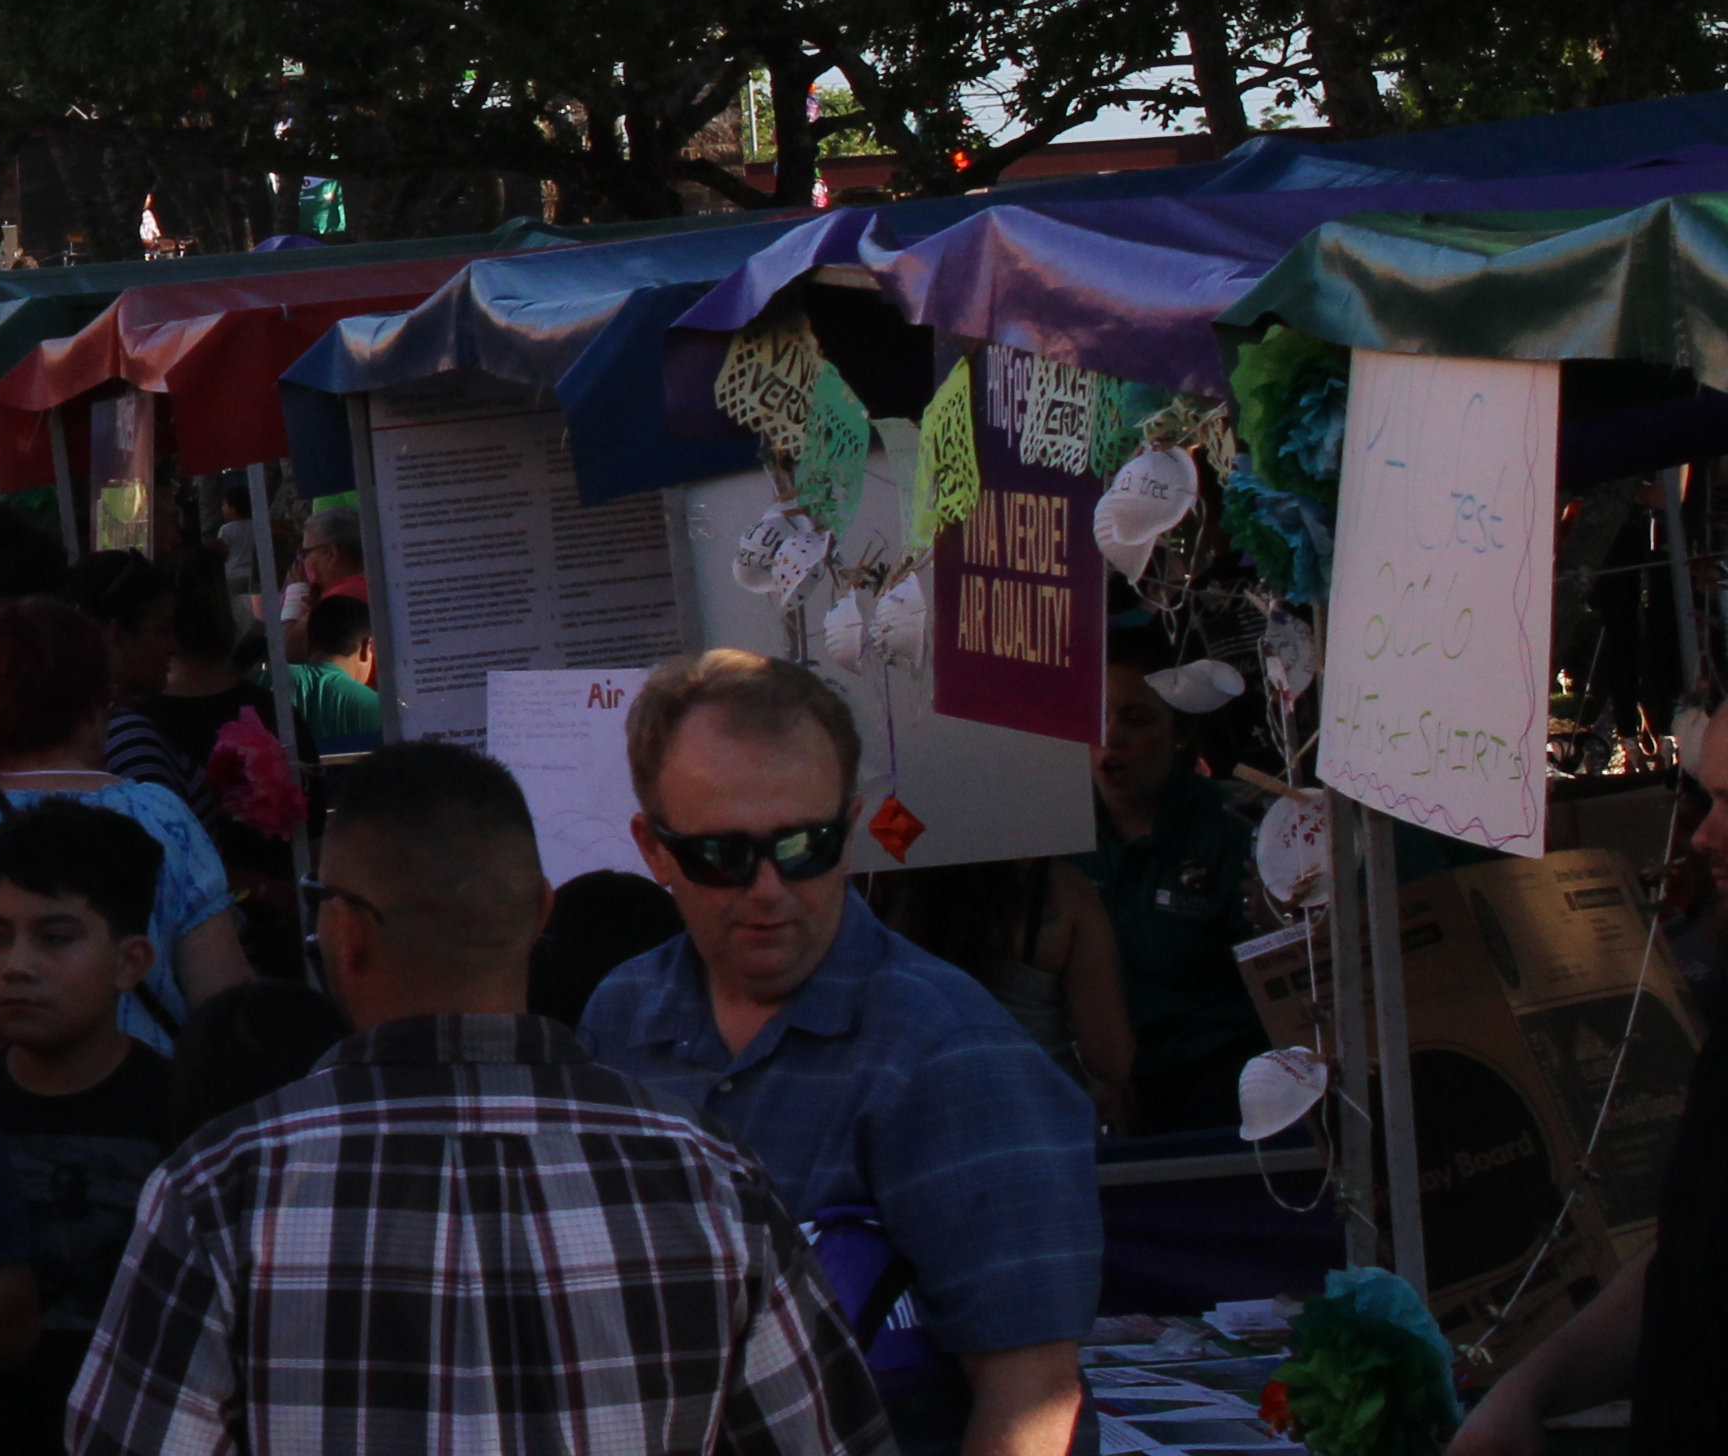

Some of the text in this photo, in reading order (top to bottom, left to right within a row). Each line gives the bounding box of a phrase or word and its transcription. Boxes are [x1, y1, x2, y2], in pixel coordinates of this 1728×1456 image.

[962, 489, 1069, 577] VIVA VERDE!
[957, 573, 1071, 668] AIR QUALITY!
[587, 679, 624, 709] Air
[1454, 1129, 1536, 1179] Board
